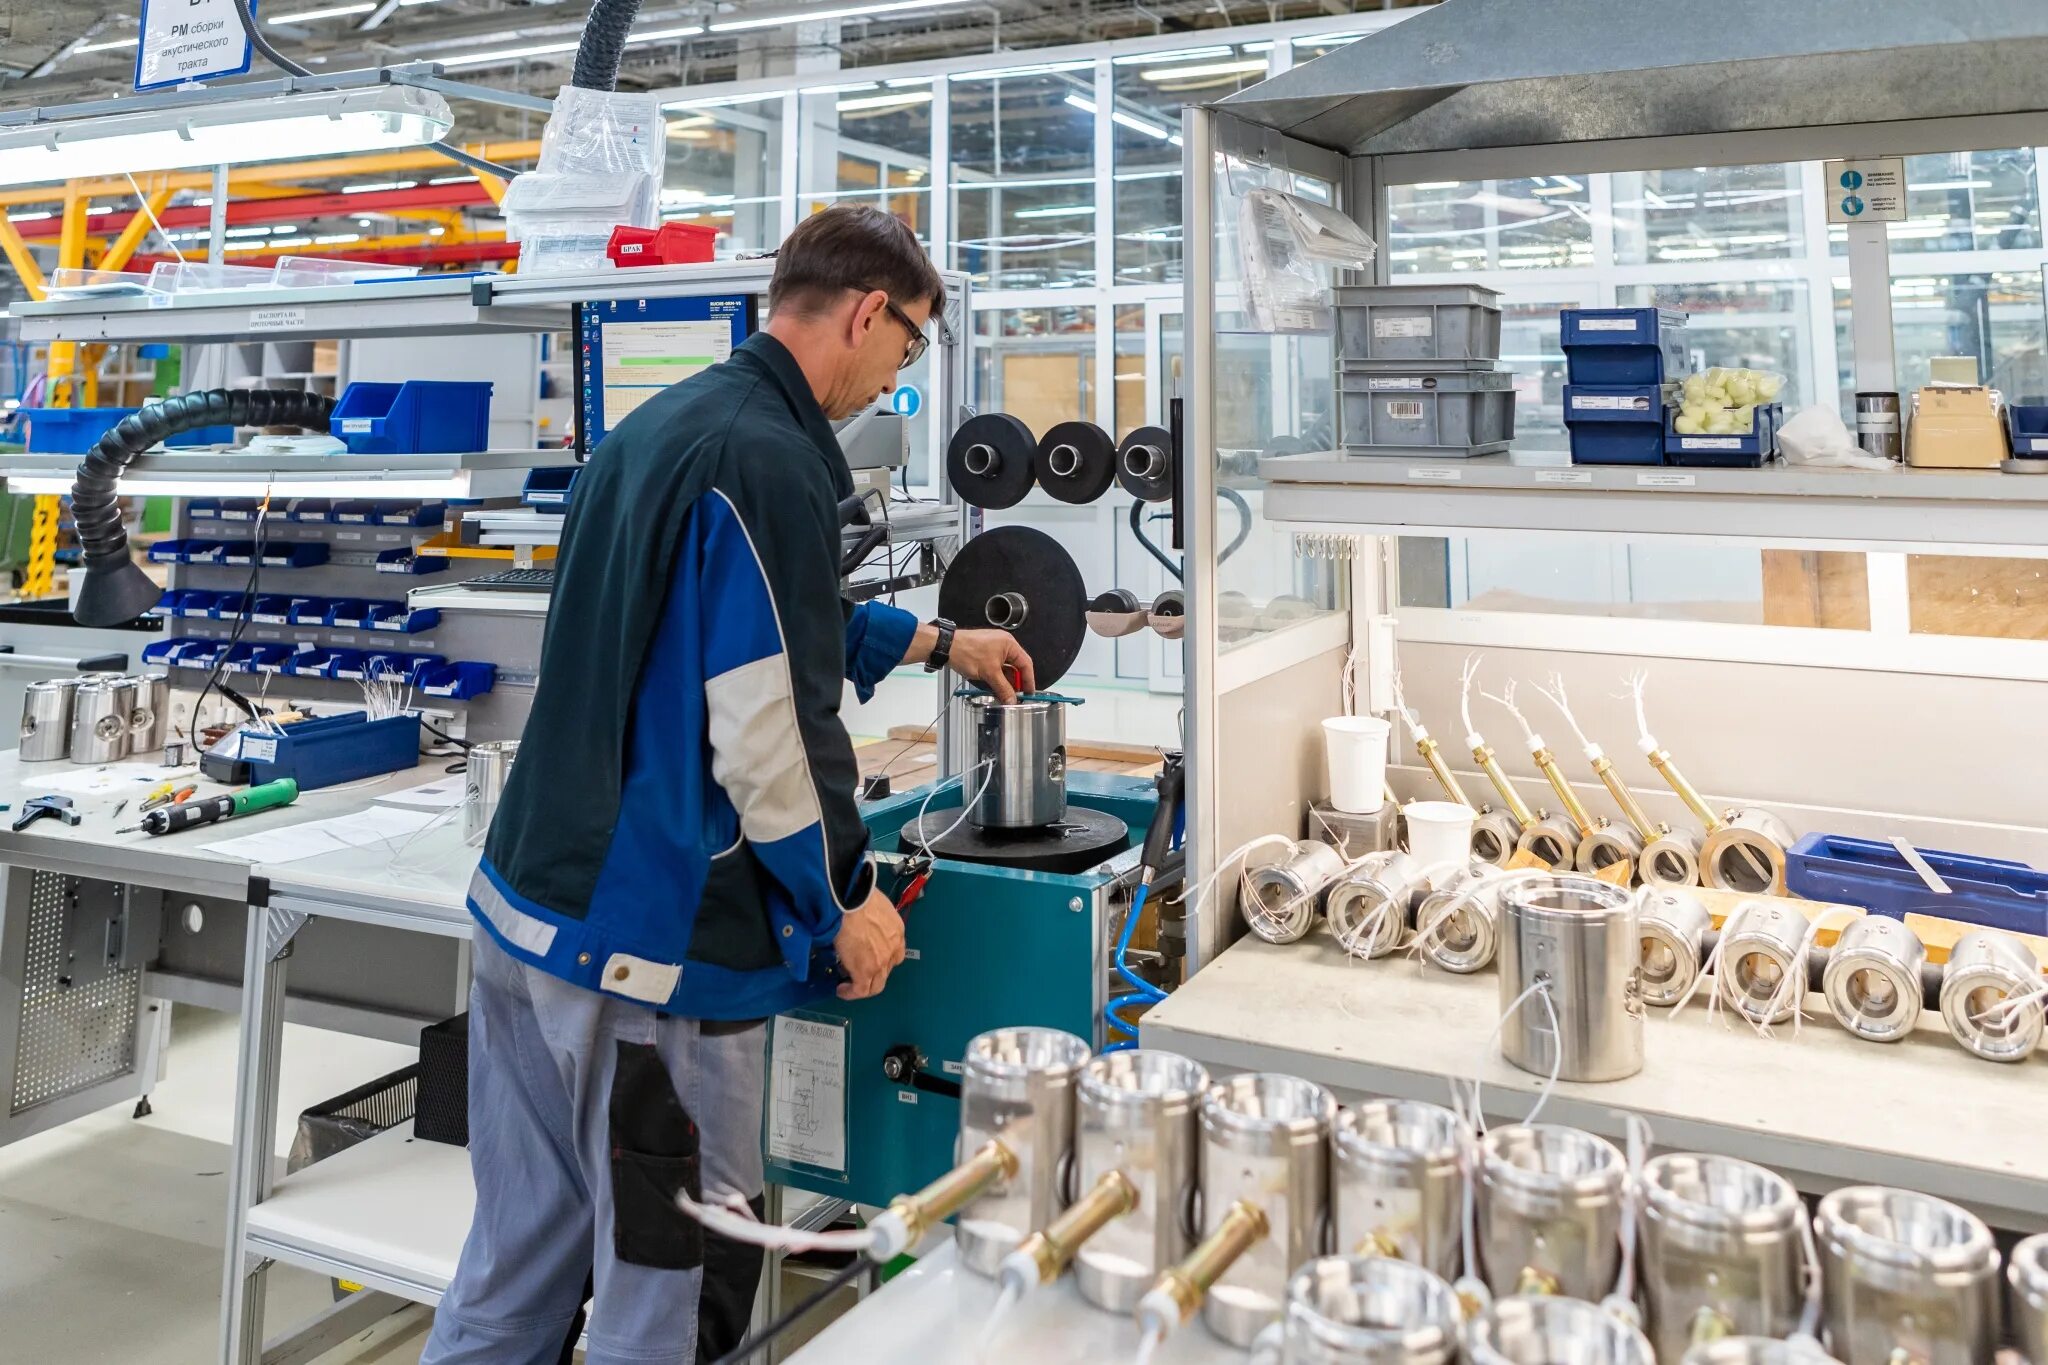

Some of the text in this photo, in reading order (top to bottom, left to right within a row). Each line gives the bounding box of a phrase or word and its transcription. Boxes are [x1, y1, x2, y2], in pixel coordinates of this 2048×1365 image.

[171, 20, 224, 36] РМ сборки
[161, 36, 229, 57] акустического
[177, 57, 208, 72] тракта
[622, 245, 641, 253] БРАК
[258, 311, 288, 319] ПАСПОРТА
